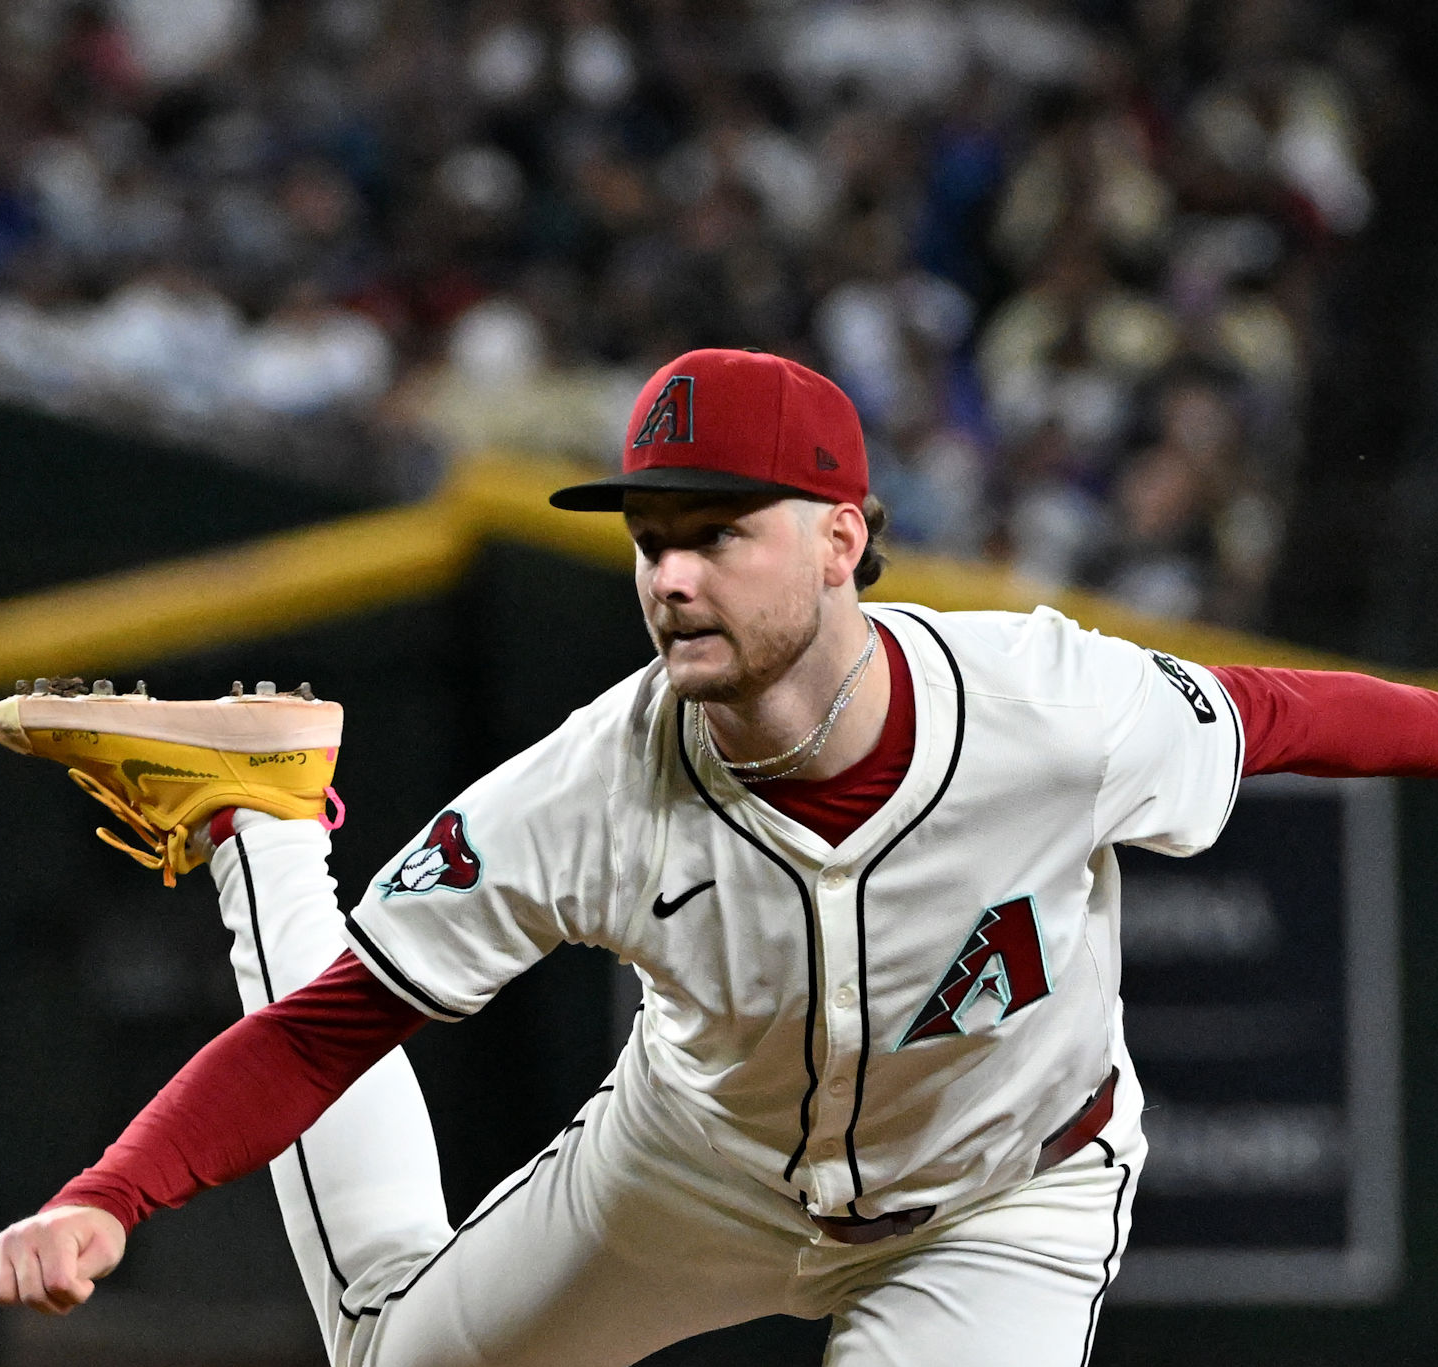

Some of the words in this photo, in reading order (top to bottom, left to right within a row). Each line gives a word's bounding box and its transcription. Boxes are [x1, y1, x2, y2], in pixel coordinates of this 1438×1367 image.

[633, 375, 694, 448] A
[258, 752, 307, 765] Carson
[891, 894, 1054, 1053] A
